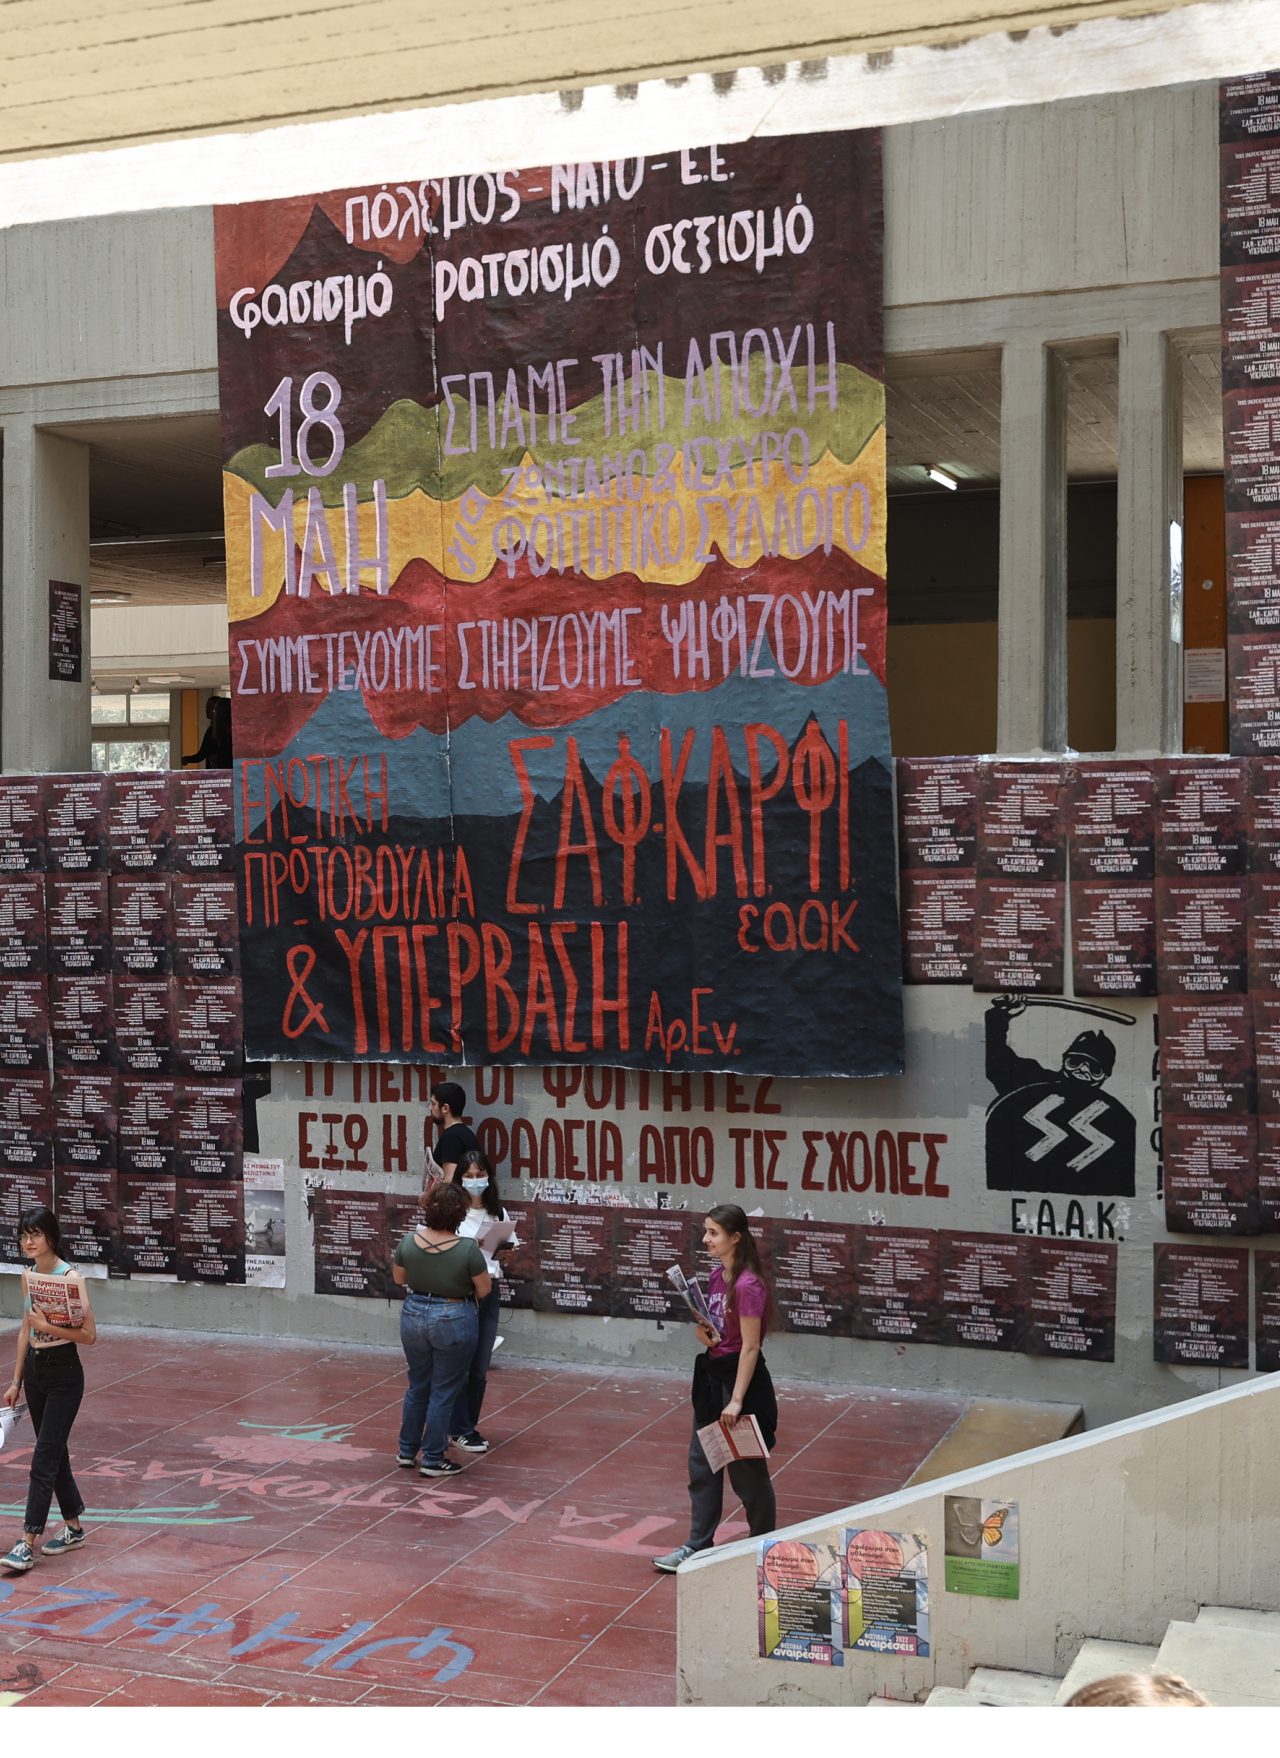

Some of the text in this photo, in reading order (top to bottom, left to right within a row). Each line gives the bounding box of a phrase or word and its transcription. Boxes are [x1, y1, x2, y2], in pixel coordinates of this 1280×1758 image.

[229, 194, 814, 345] φασισμό ρατσισμό σεξισμό
[263, 372, 346, 478] 18
[442, 321, 839, 456] ΣΠΑΜΕ ΤΗΝ ΑΠΟΧΗ
[681, 427, 811, 492] ΙΣΧΥΡΟ
[249, 478, 390, 598] ΜΑΗ
[492, 481, 872, 580] ΦΟΙΤΗΤΙΚΟ ΣΥΛΛΟΓΟ
[236, 587, 875, 697] ΣΥΜΜΕΤΕΧΟΥΜΕ ΣΤΗΡΙΖΟΥΜΕ ΨΗΦΙΖΟΥΜΕ
[241, 751, 389, 846] ΕΝΩΤΙΚΗ
[243, 844, 476, 928] ΠΡΩΤΟΒΟΥΛΙΑ
[281, 944, 330, 1039] &
[335, 920, 629, 1056] ΥΠΕΡΒΑΣΗ
[298, 1111, 368, 1170] ΕΞΩ
[382, 1114, 408, 1172] Η
[639, 1124, 715, 1188] ΑΠΟ
[728, 1127, 789, 1190] ΤΙΣ
[801, 1129, 950, 1198] ΣΧΟΛΕΣ
